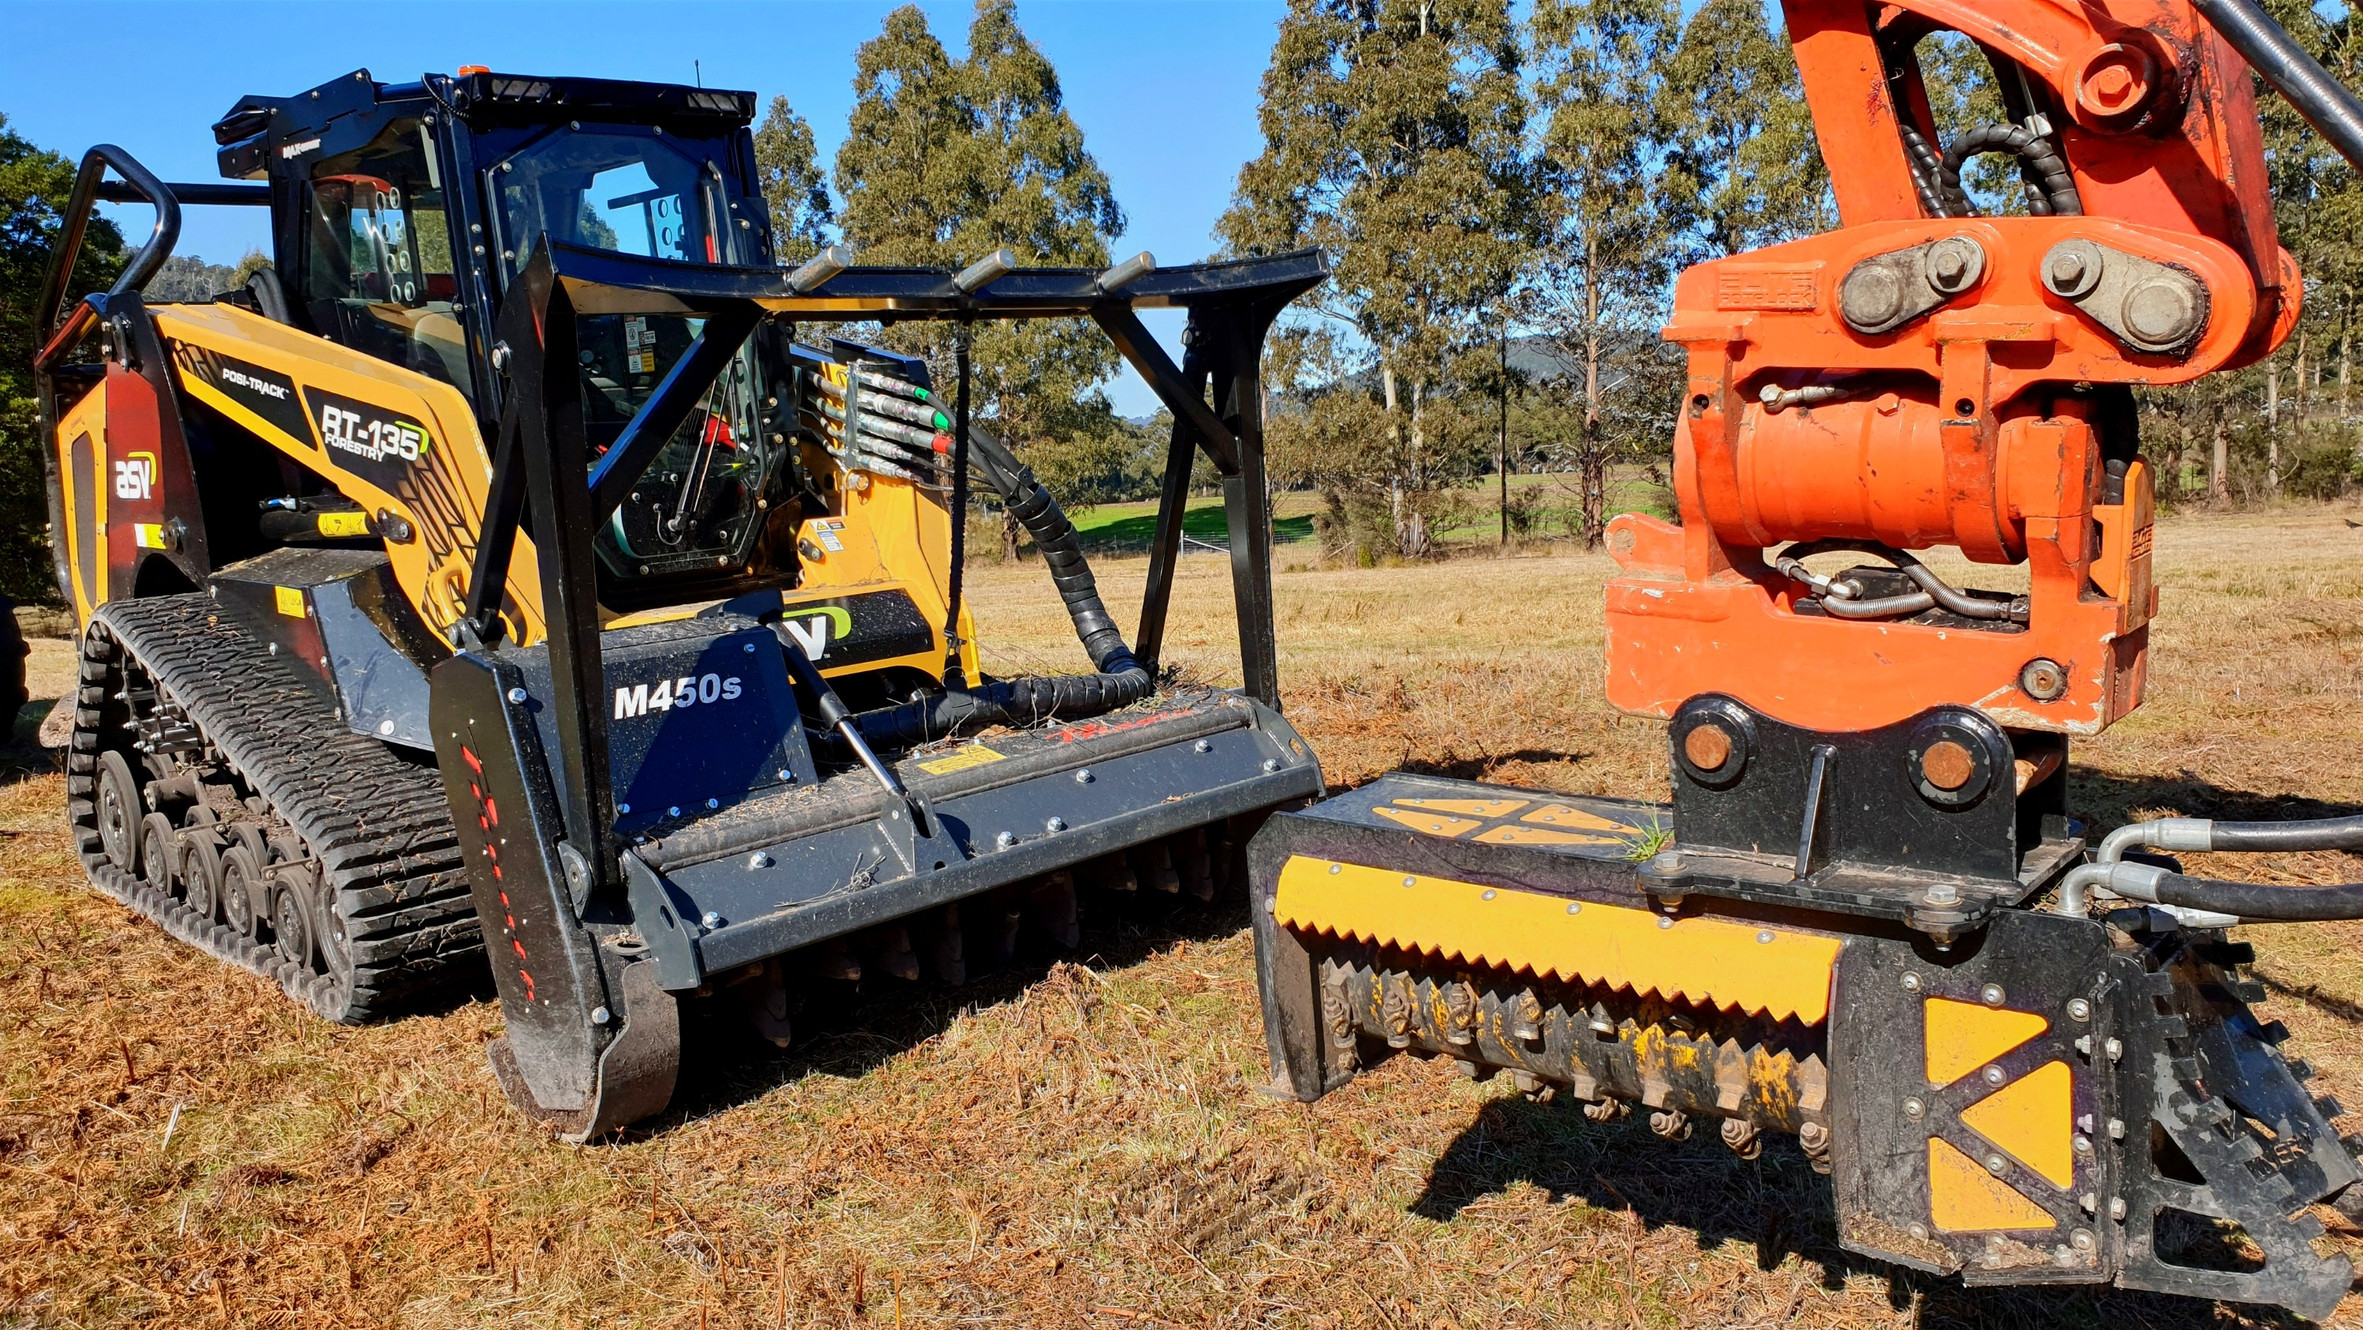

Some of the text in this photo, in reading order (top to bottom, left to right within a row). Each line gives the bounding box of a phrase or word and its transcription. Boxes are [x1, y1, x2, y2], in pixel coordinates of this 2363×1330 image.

[222, 368, 286, 400] POSI-TRACK
[322, 405, 420, 462] RT-135
[325, 433, 385, 462] FORESTRY
[614, 673, 742, 720] M450s
